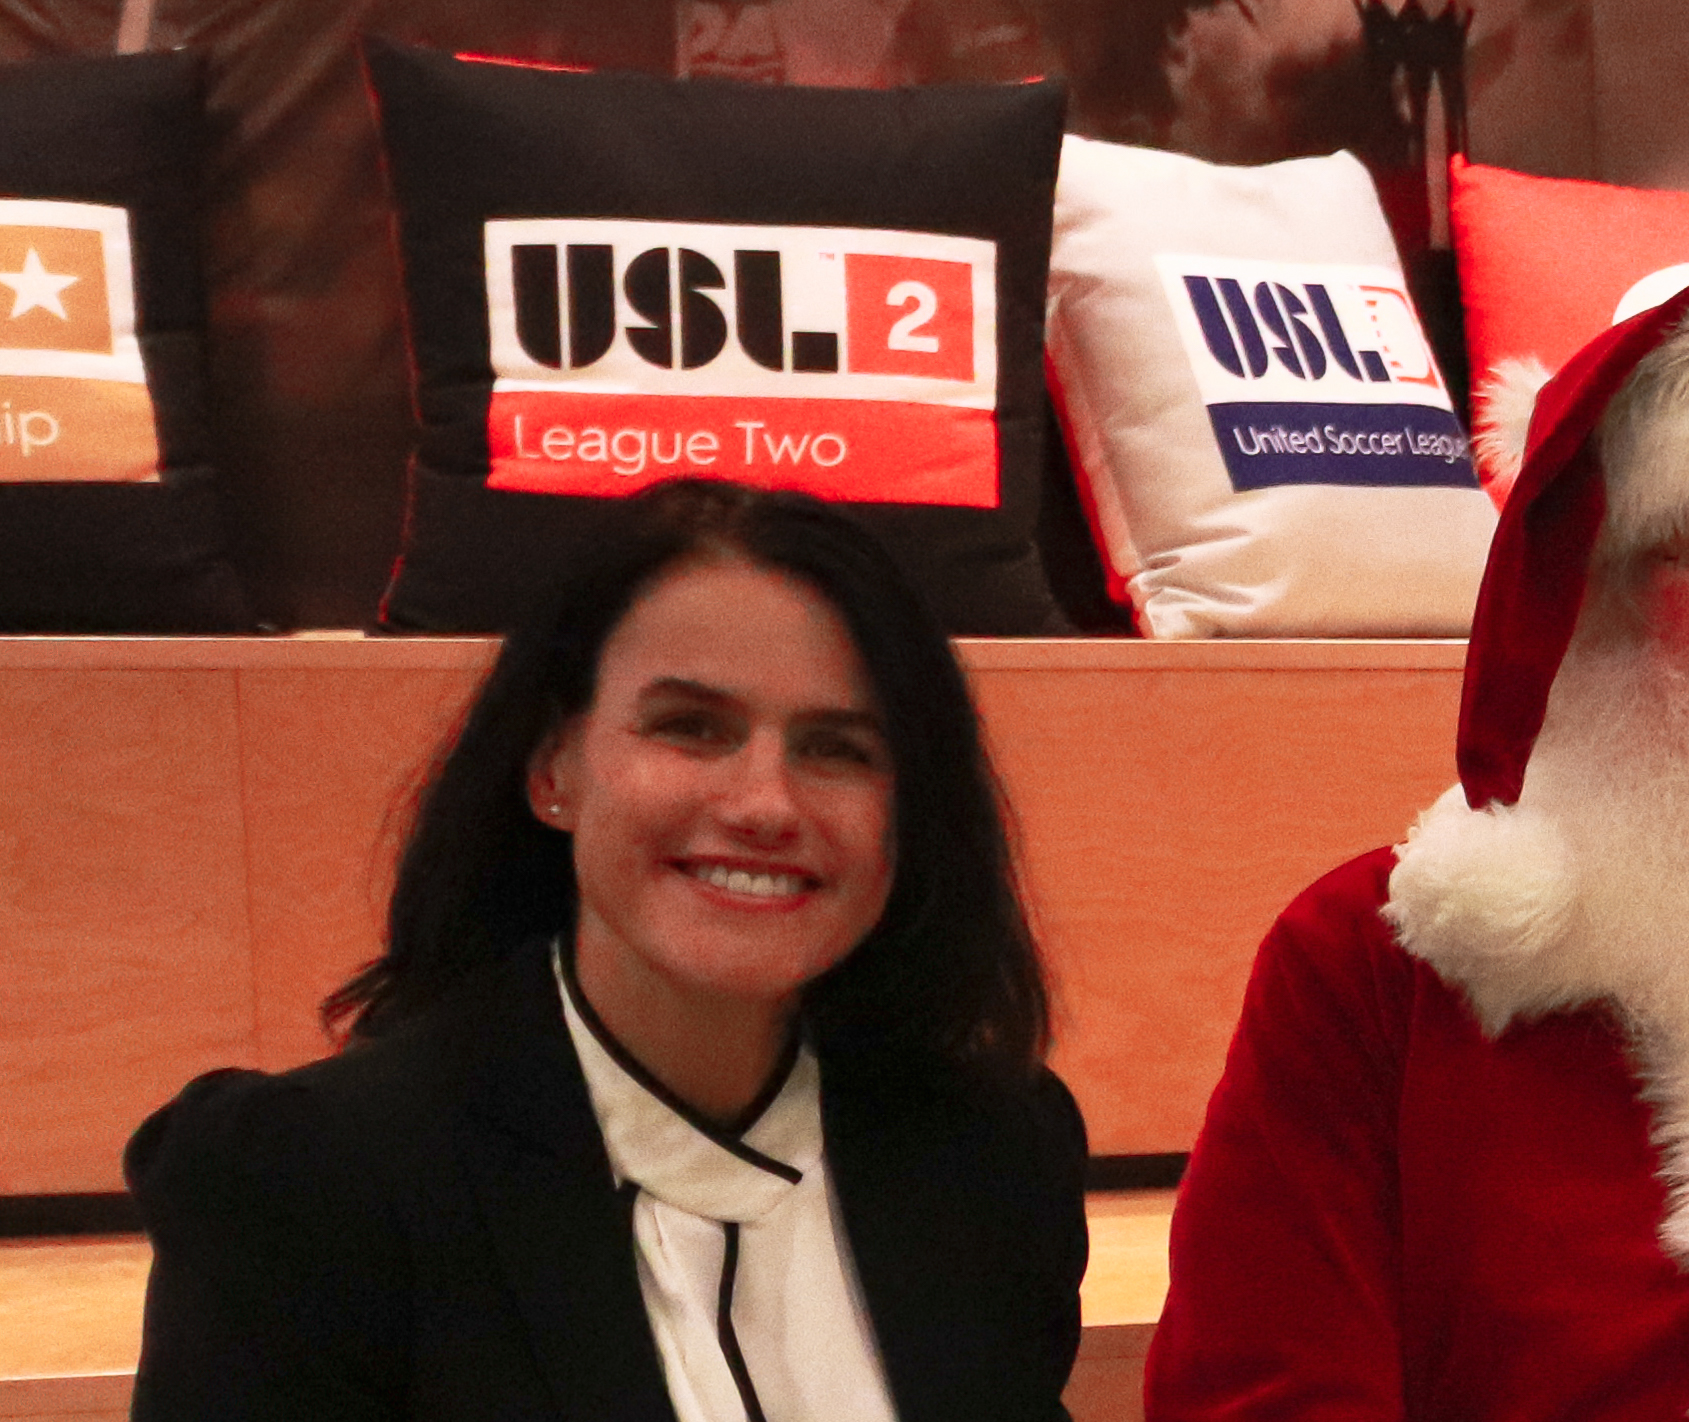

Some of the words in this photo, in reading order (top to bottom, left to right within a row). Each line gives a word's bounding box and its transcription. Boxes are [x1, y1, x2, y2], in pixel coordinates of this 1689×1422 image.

[511, 244, 838, 372] USL
[885, 281, 940, 353] 2
[1183, 275, 1392, 382] USL
[514, 415, 720, 475] League
[734, 420, 846, 467] Two
[1233, 425, 1323, 456] United
[1323, 424, 1402, 456] Soccer
